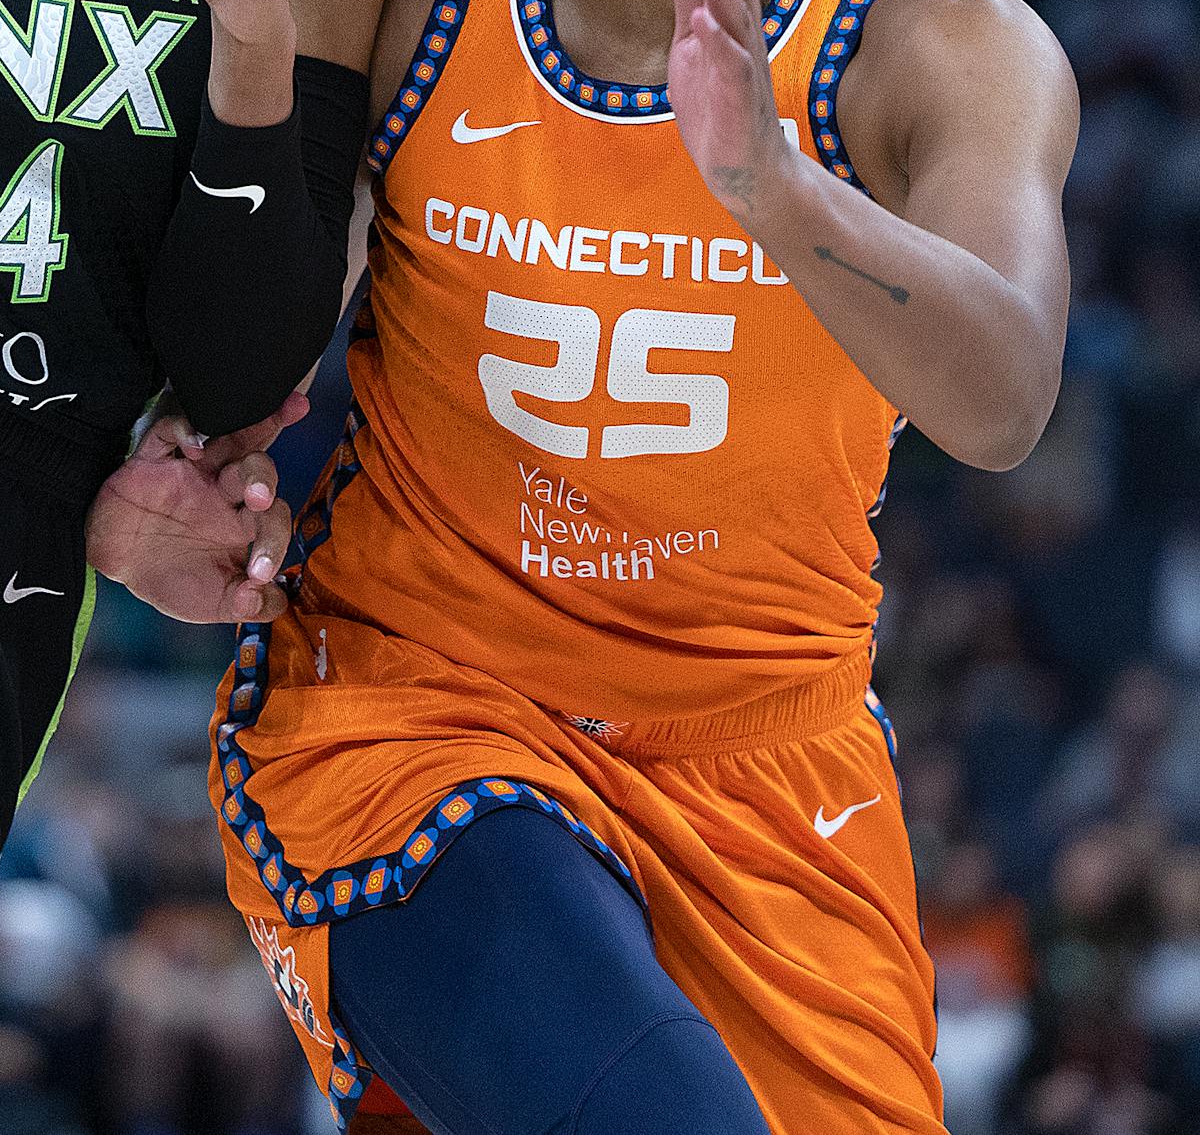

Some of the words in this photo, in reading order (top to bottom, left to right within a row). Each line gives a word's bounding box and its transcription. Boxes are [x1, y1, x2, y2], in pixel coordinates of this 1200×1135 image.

[477, 290, 737, 460] 25
[518, 461, 588, 515] Yale
[520, 539, 655, 581] Health
